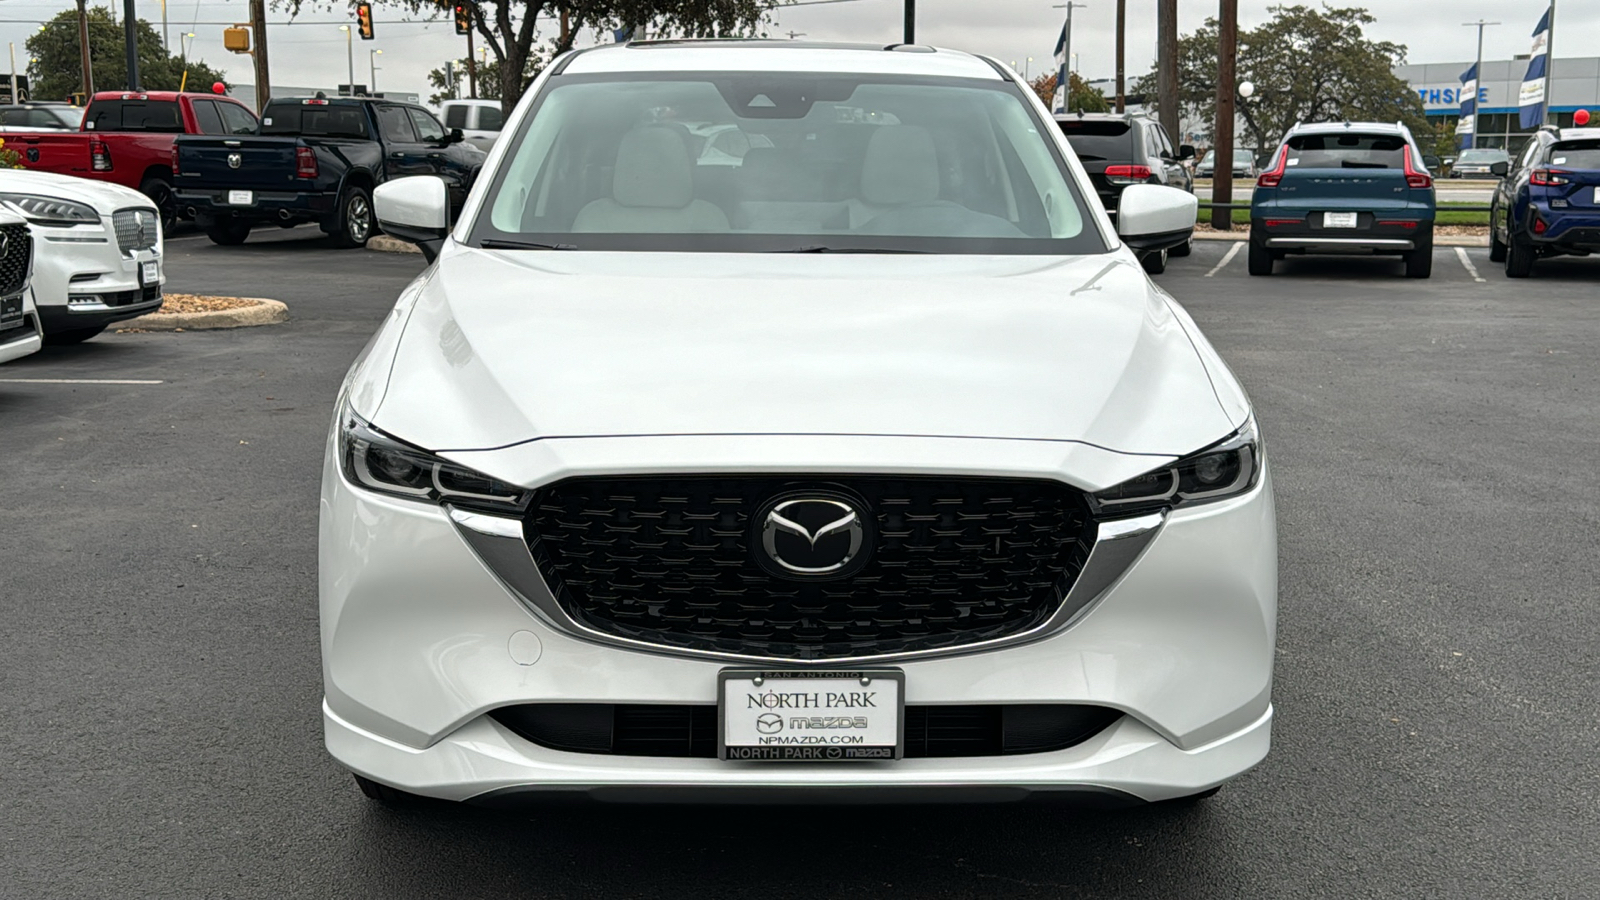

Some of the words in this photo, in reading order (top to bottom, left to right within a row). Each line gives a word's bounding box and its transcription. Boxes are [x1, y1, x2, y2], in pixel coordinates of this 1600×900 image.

[763, 671, 792, 679] SAN
[797, 671, 860, 679] ANTONIO
[747, 690, 819, 710] NORTH
[825, 692, 877, 708] PARK
[758, 735, 864, 744] NPMAZDA.COM
[730, 747, 780, 759] NORTH
[784, 747, 823, 759] PARK
